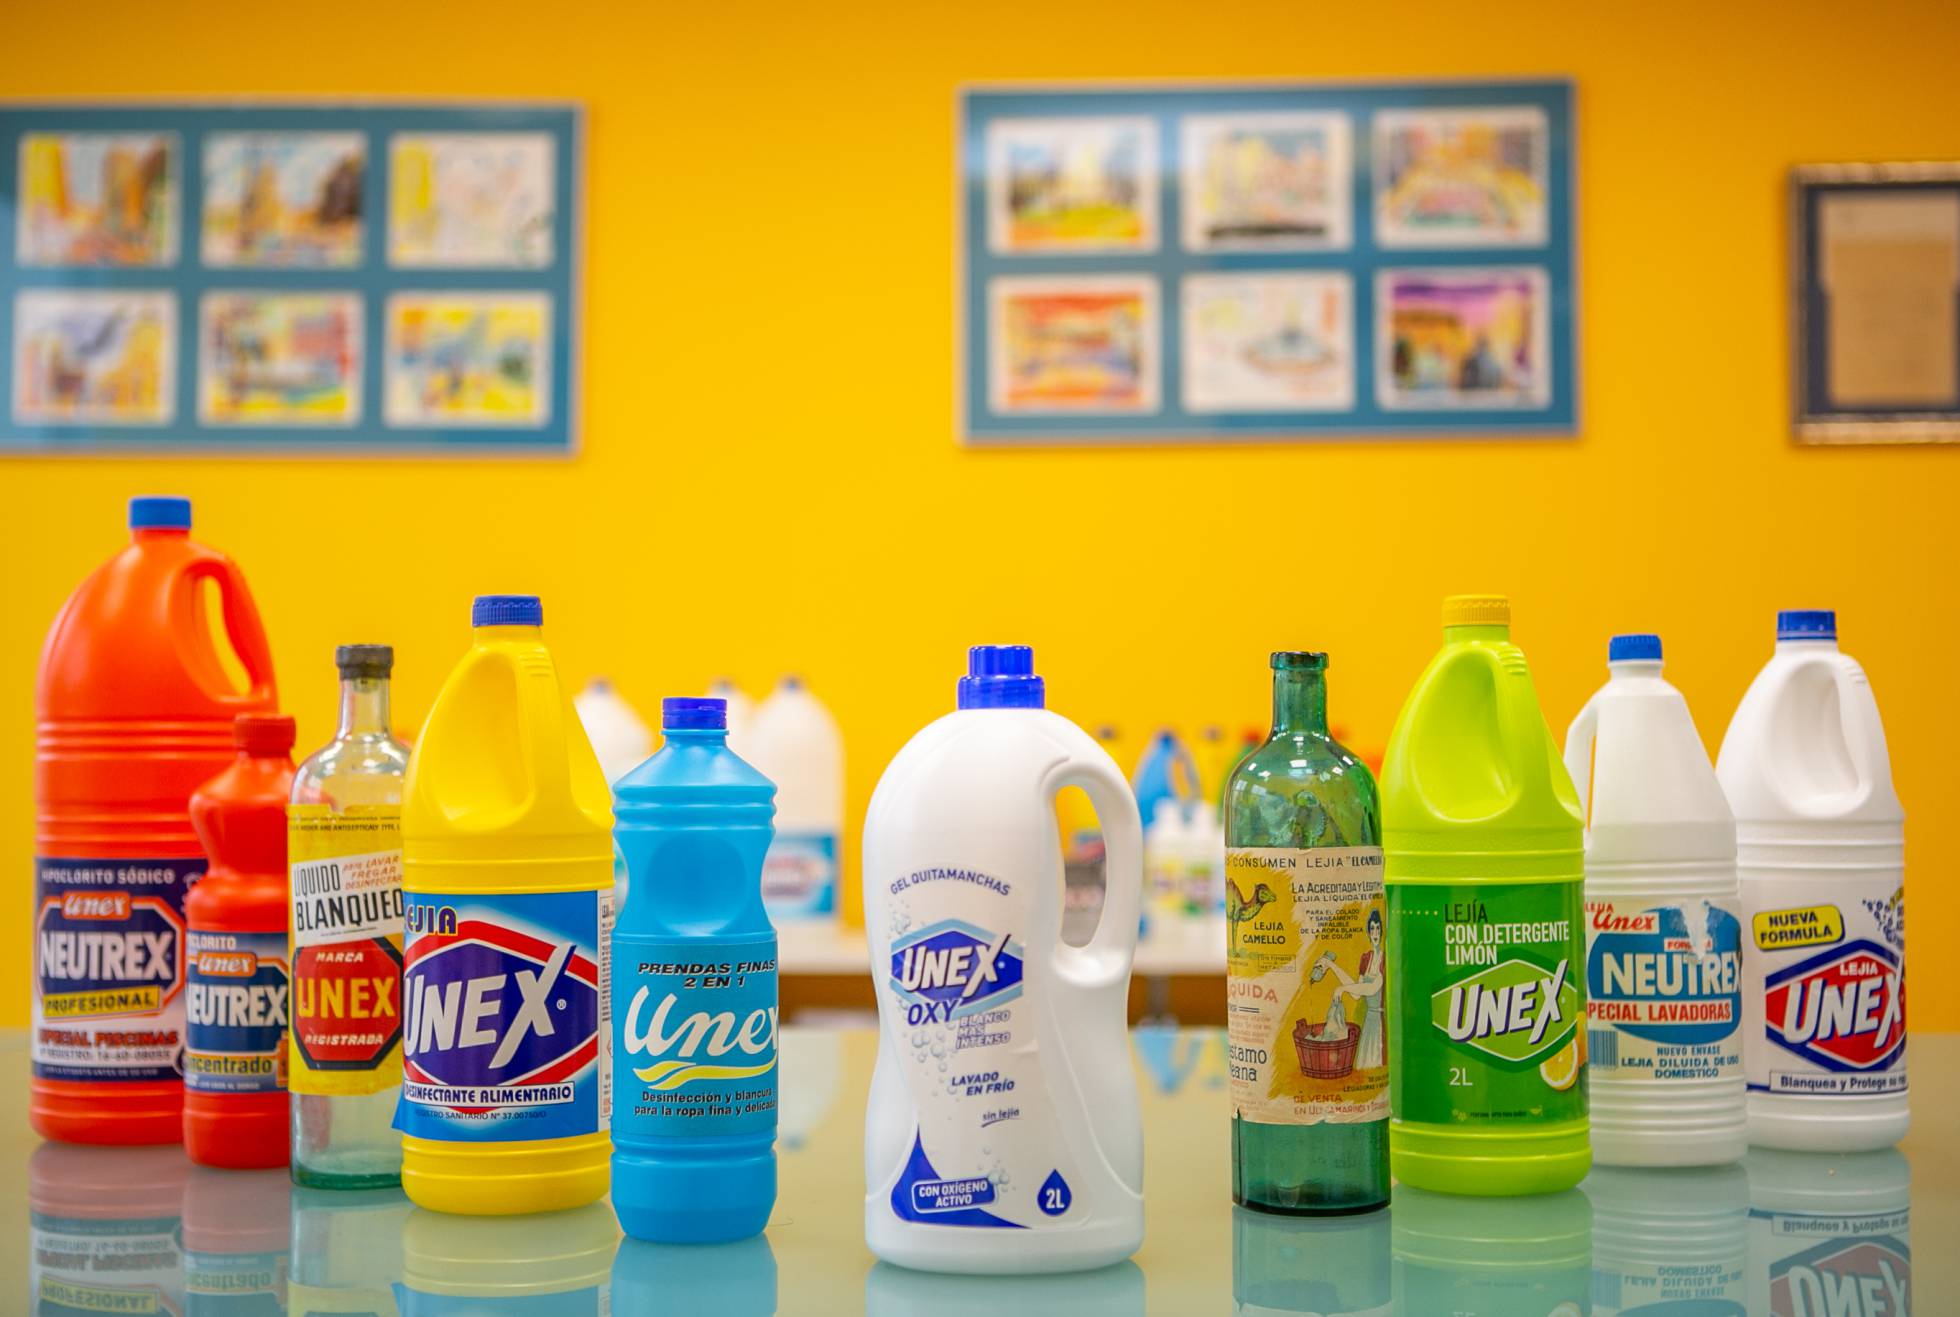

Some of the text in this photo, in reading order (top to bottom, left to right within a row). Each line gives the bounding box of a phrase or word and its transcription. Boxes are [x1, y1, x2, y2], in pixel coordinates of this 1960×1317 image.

[1232, 857, 1297, 868] CONSUMEN
[1306, 857, 1344, 868] LEJIA
[117, 865, 176, 885] SÓDICO
[890, 868, 1011, 896] GEL QUITAMANCHAS
[1291, 882, 1305, 894] LA
[1293, 894, 1320, 903] LEJIA
[1323, 893, 1358, 902] LIQUIDA
[296, 887, 404, 932] BLANQUEO
[1444, 899, 1488, 923] LEJÍA
[406, 904, 459, 936] EJIA
[1254, 921, 1284, 931] LEJIA
[1768, 911, 1818, 928] NUEVA
[1243, 935, 1286, 945] CAMELLO
[1445, 920, 1569, 944] CON DETERGENTE
[1760, 925, 1833, 944] FORMULA
[189, 934, 237, 950] CLORITO
[40, 930, 174, 981] NEUTREX
[315, 952, 364, 963] MARCA
[1446, 941, 1498, 965] LIMÓN
[638, 959, 775, 975] PRENDAS FINAS
[901, 934, 1010, 998] UNEX
[1602, 952, 1741, 996] NEUTREX
[1839, 962, 1878, 976] LEJIA
[684, 976, 745, 988] 2 EN 1
[46, 991, 153, 1012] PROFESIONAL
[297, 977, 396, 1019] UNEX
[1230, 983, 1278, 1003] QUIDA
[1448, 959, 1569, 1044] UNEX
[1783, 953, 1904, 1048] UNEX
[404, 942, 576, 1069] UNEX
[907, 998, 961, 1026] OXY
[1587, 1003, 1731, 1021] PECIAL LAVADORAS
[959, 1010, 1011, 1027] BLANCO
[304, 1033, 384, 1046] REGISTRADA
[955, 1031, 1011, 1050] INTENSO
[1656, 1045, 1720, 1056] NUEVO ENVASE
[1621, 1057, 1653, 1067] LEJIA
[1659, 1058, 1709, 1068] DILUIDA
[1713, 1056, 1725, 1066] DE
[951, 1071, 999, 1087] LAVADO
[1449, 1067, 1473, 1087] 2L
[1655, 1068, 1719, 1079] DOMESTICO
[966, 1078, 1015, 1096] EN FRÍO
[1781, 1076, 1836, 1091] Blanquea
[1840, 1078, 1847, 1091] y
[1850, 1075, 1887, 1090] Protege
[480, 1085, 571, 1104] ALIMENTARIO
[642, 1091, 721, 1103] Desinfección
[725, 1093, 731, 1104] y
[1309, 1094, 1342, 1103] VENTA
[445, 1111, 489, 1120] SANITARIO
[634, 1106, 658, 1116] para
[661, 1105, 672, 1116] la
[676, 1107, 705, 1118] ropa
[709, 1105, 732, 1116] fina
[735, 1107, 742, 1117] y
[983, 1112, 996, 1121] sin
[919, 1180, 988, 1198] CON OXÍGENO
[935, 1194, 973, 1208] ACTIVO
[1046, 1188, 1065, 1209] 2L
